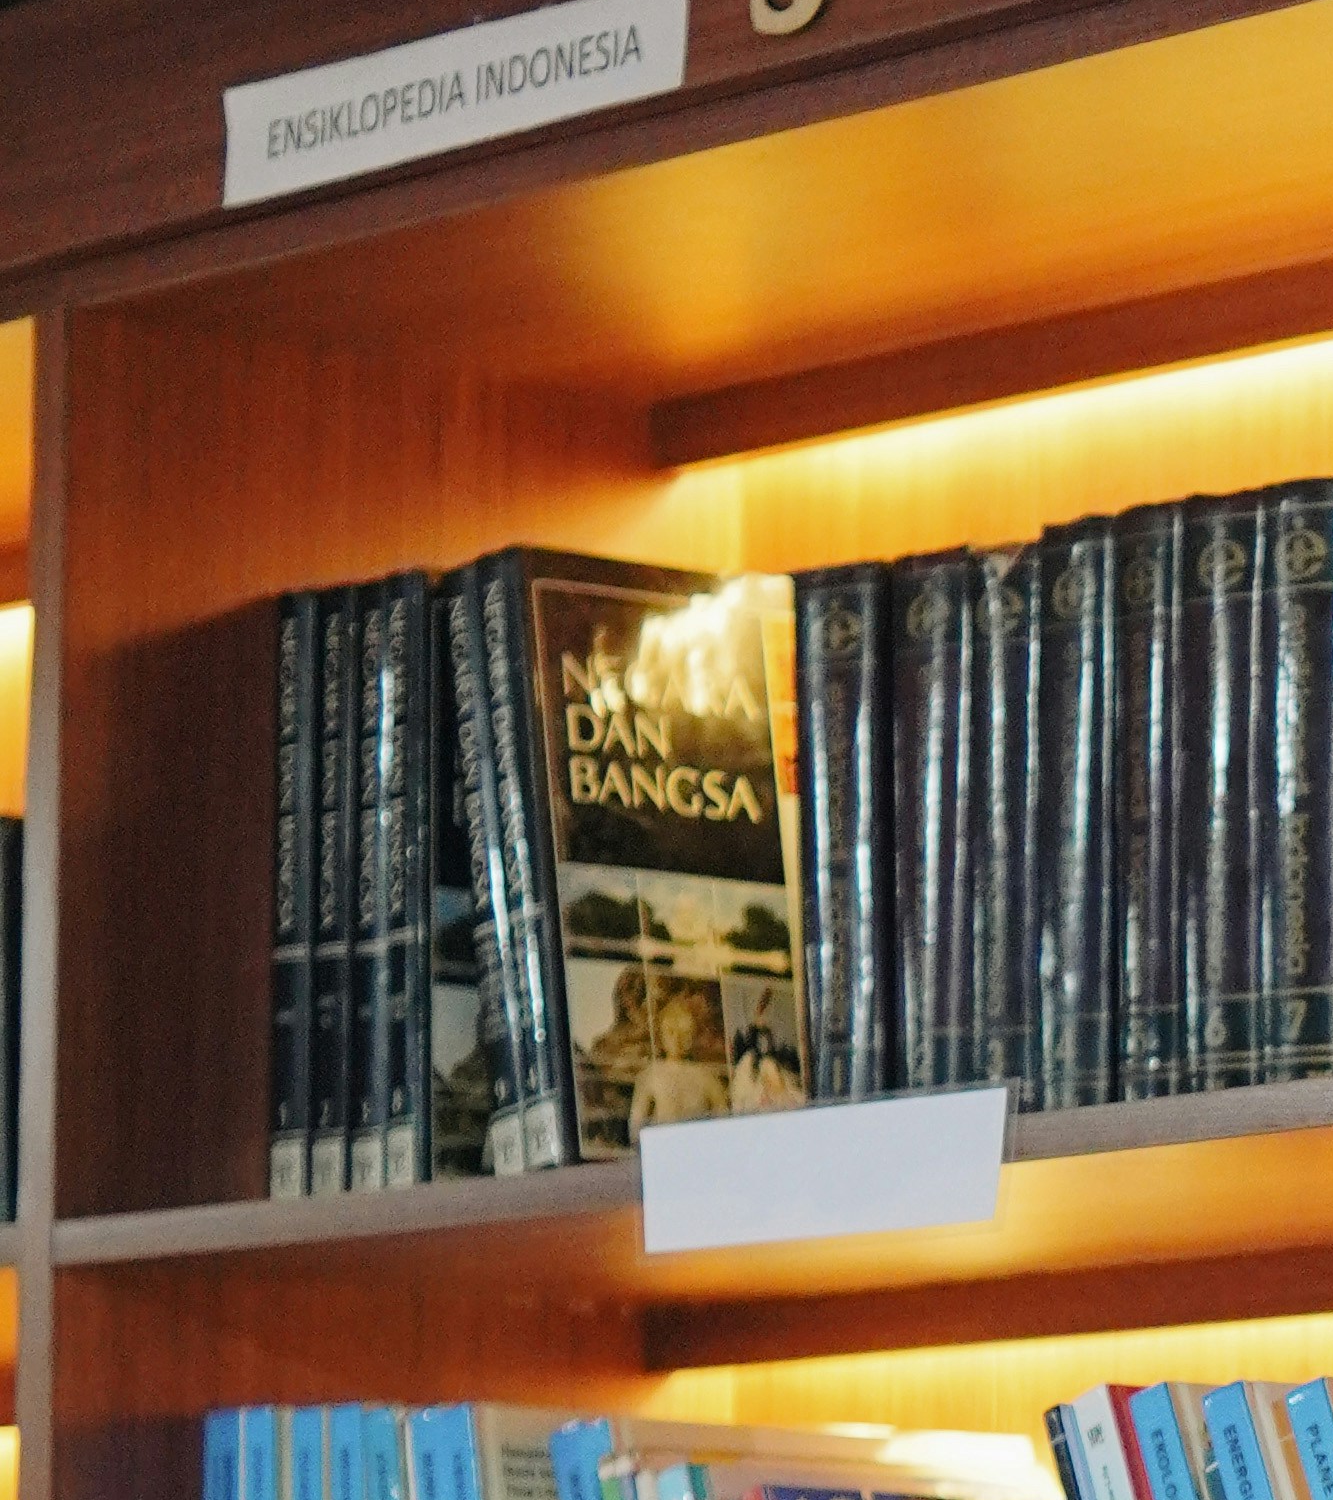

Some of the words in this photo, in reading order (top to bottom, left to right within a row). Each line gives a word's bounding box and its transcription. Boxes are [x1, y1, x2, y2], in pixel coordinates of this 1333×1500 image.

[266, 73, 465, 160] ENSIKLOPEDIA
[476, 24, 642, 99] INDONESIA
[565, 702, 673, 761] DAN
[568, 754, 762, 825] BANGSA
